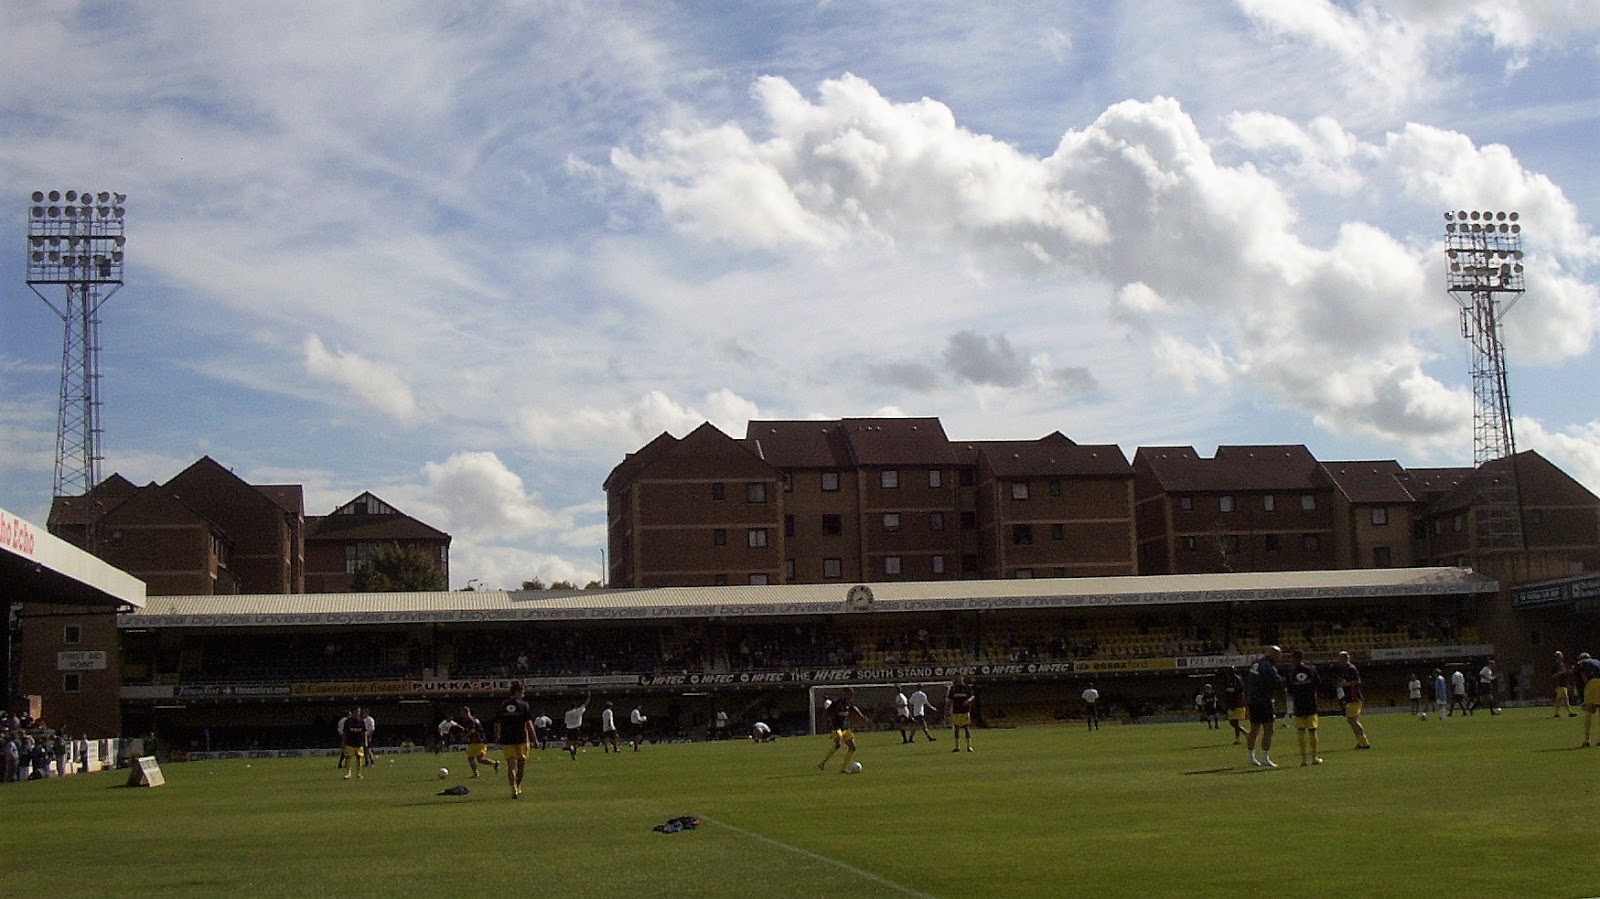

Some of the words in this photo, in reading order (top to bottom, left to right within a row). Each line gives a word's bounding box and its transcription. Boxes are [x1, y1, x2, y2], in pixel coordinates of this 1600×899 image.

[13, 519, 35, 555] Echo
[651, 675, 686, 685] HI-TEC
[701, 674, 735, 684] HI-TEC
[751, 672, 785, 682] HI-TEC
[791, 672, 810, 681] THE
[813, 669, 852, 680] HI-TEC
[857, 669, 894, 679] SOUTH
[896, 667, 932, 677] STAND
[992, 665, 1024, 674] HI-TEC
[1038, 663, 1070, 673] HI-TEC
